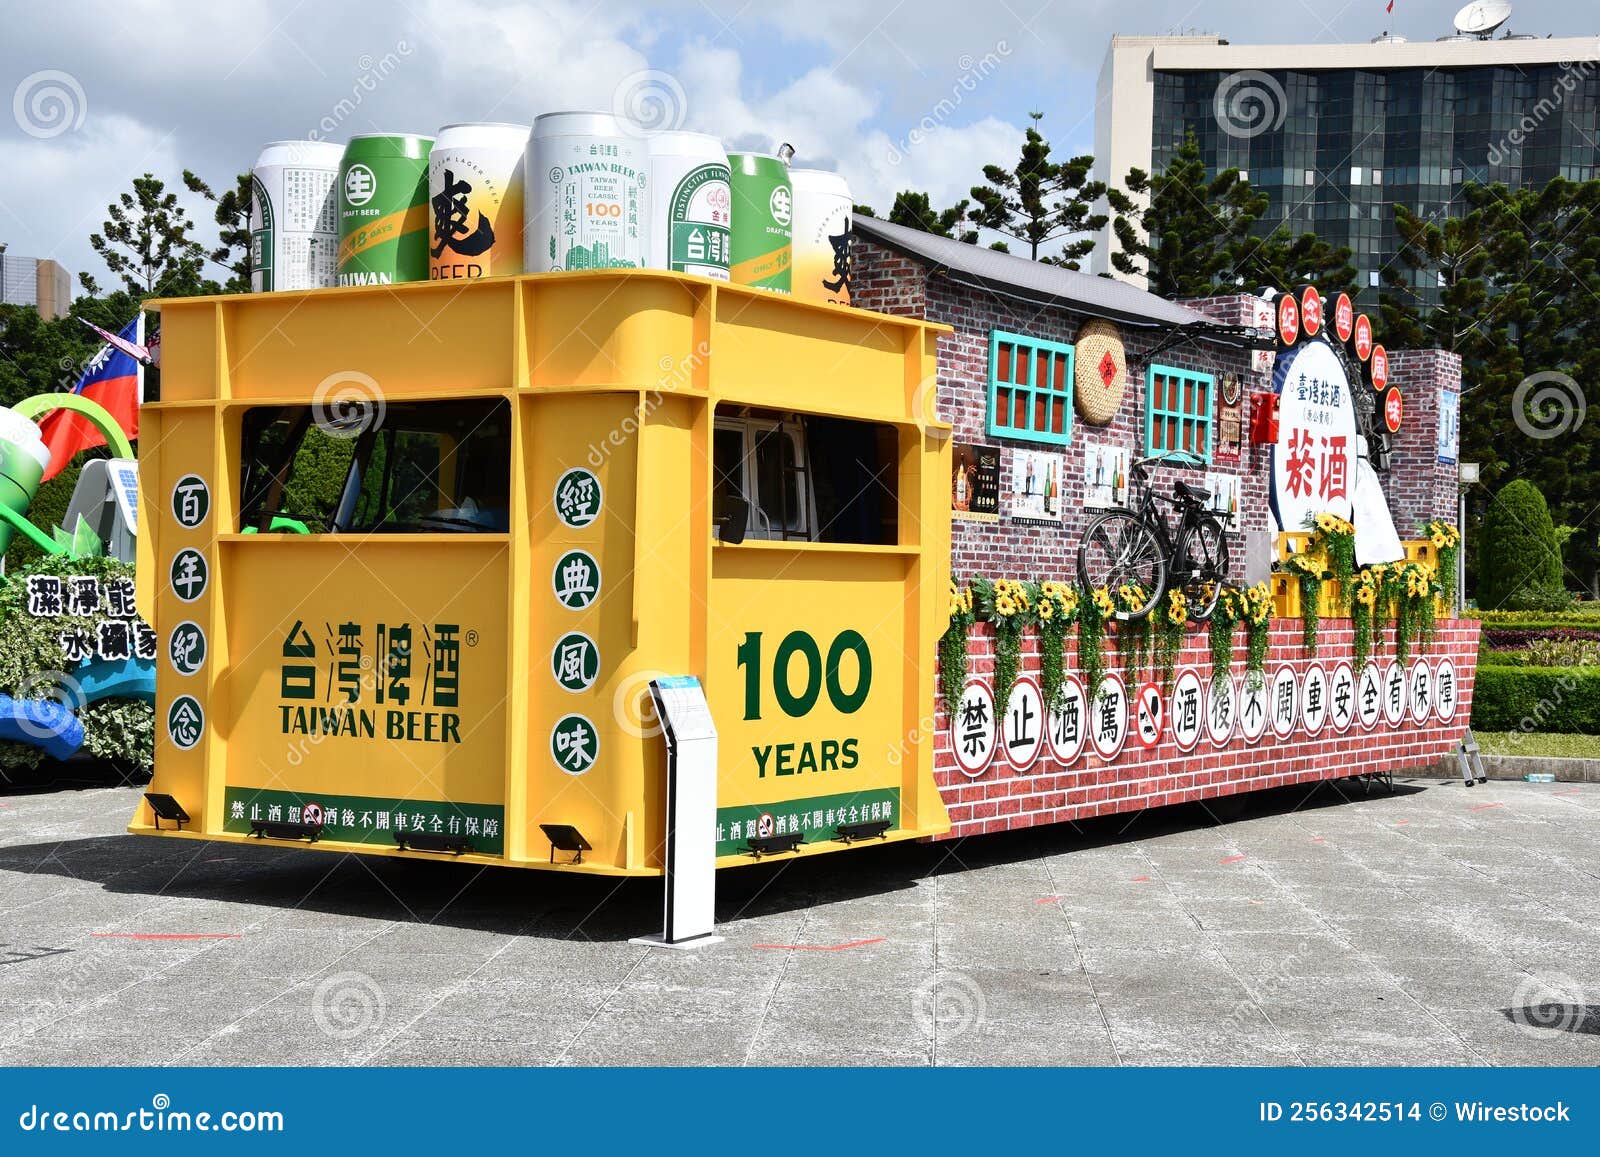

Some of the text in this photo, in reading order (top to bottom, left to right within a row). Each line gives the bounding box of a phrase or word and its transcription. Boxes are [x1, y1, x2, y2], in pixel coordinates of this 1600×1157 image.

[347, 170, 371, 199] 生
[567, 162, 635, 179] TAIWAN BEER
[586, 203, 621, 217] 100
[676, 171, 708, 218] DISTINCTIVE
[370, 224, 393, 237] DAYS
[766, 227, 784, 235] DRAFT
[1285, 427, 1348, 501] 菸酒
[171, 482, 205, 745] 百年紀念
[556, 478, 595, 768] 經典風味
[737, 629, 872, 721] 100
[278, 705, 462, 743] TAIWAN BEER
[962, 692, 1119, 758] 禁止酒駕
[752, 738, 859, 778] YEARS
[231, 801, 499, 839] 禁止酒駕 酒後不開車安全有保障
[776, 800, 892, 834] 酒後不開車安全有保障
